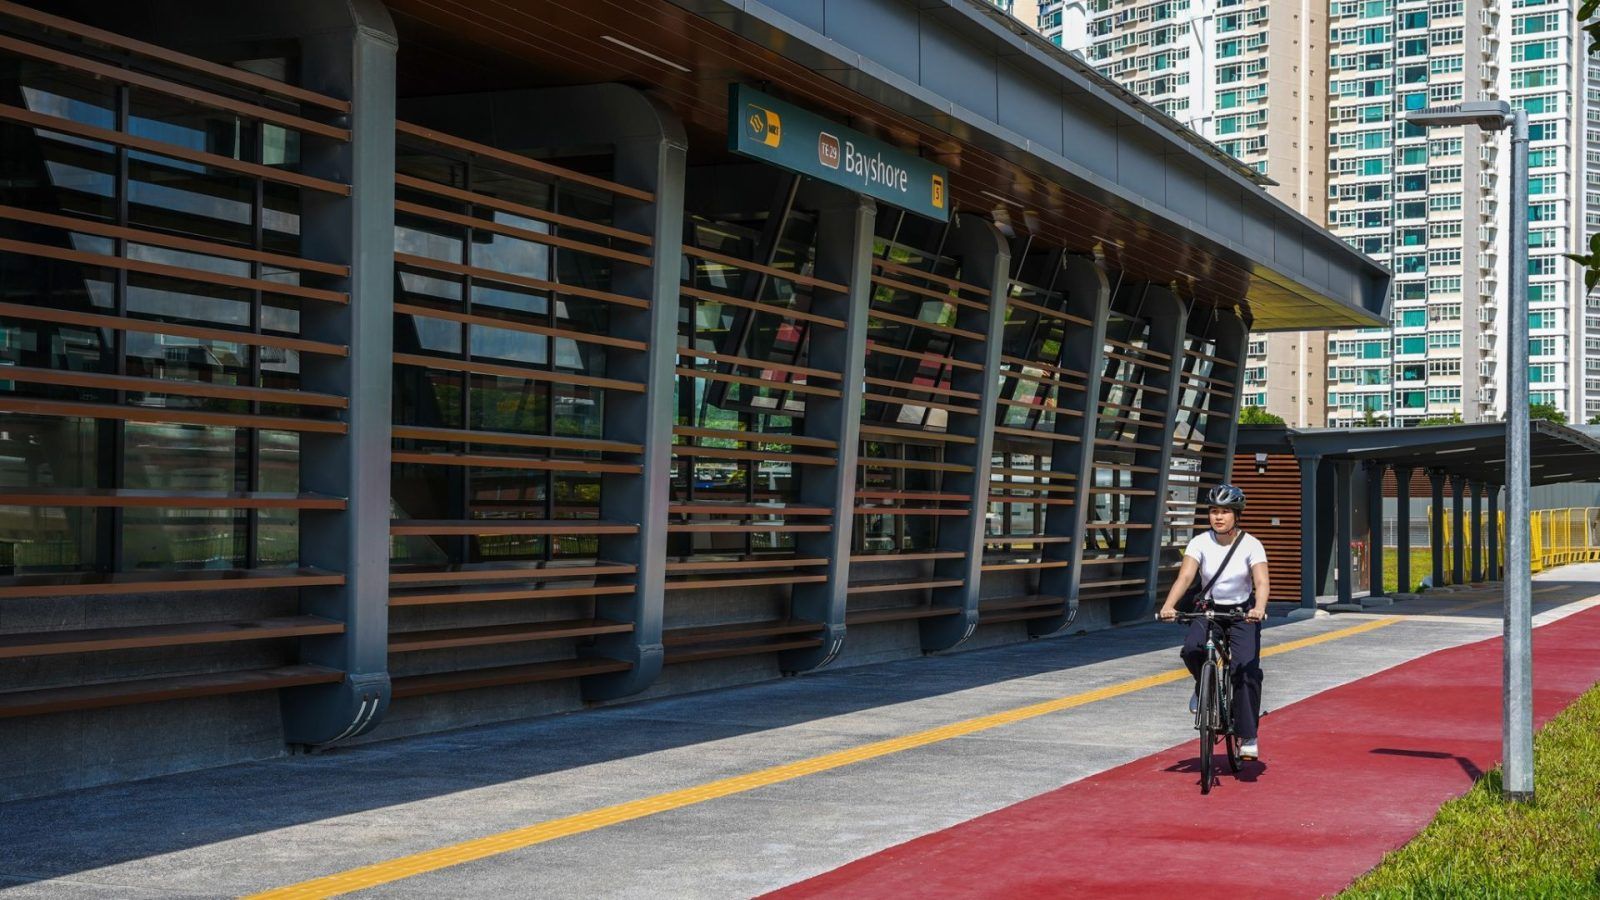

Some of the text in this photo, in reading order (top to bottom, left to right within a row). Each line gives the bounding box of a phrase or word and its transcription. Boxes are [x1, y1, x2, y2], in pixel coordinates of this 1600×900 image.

[768, 124, 779, 136] MRT
[821, 141, 908, 192] TE 29 Bayshore
